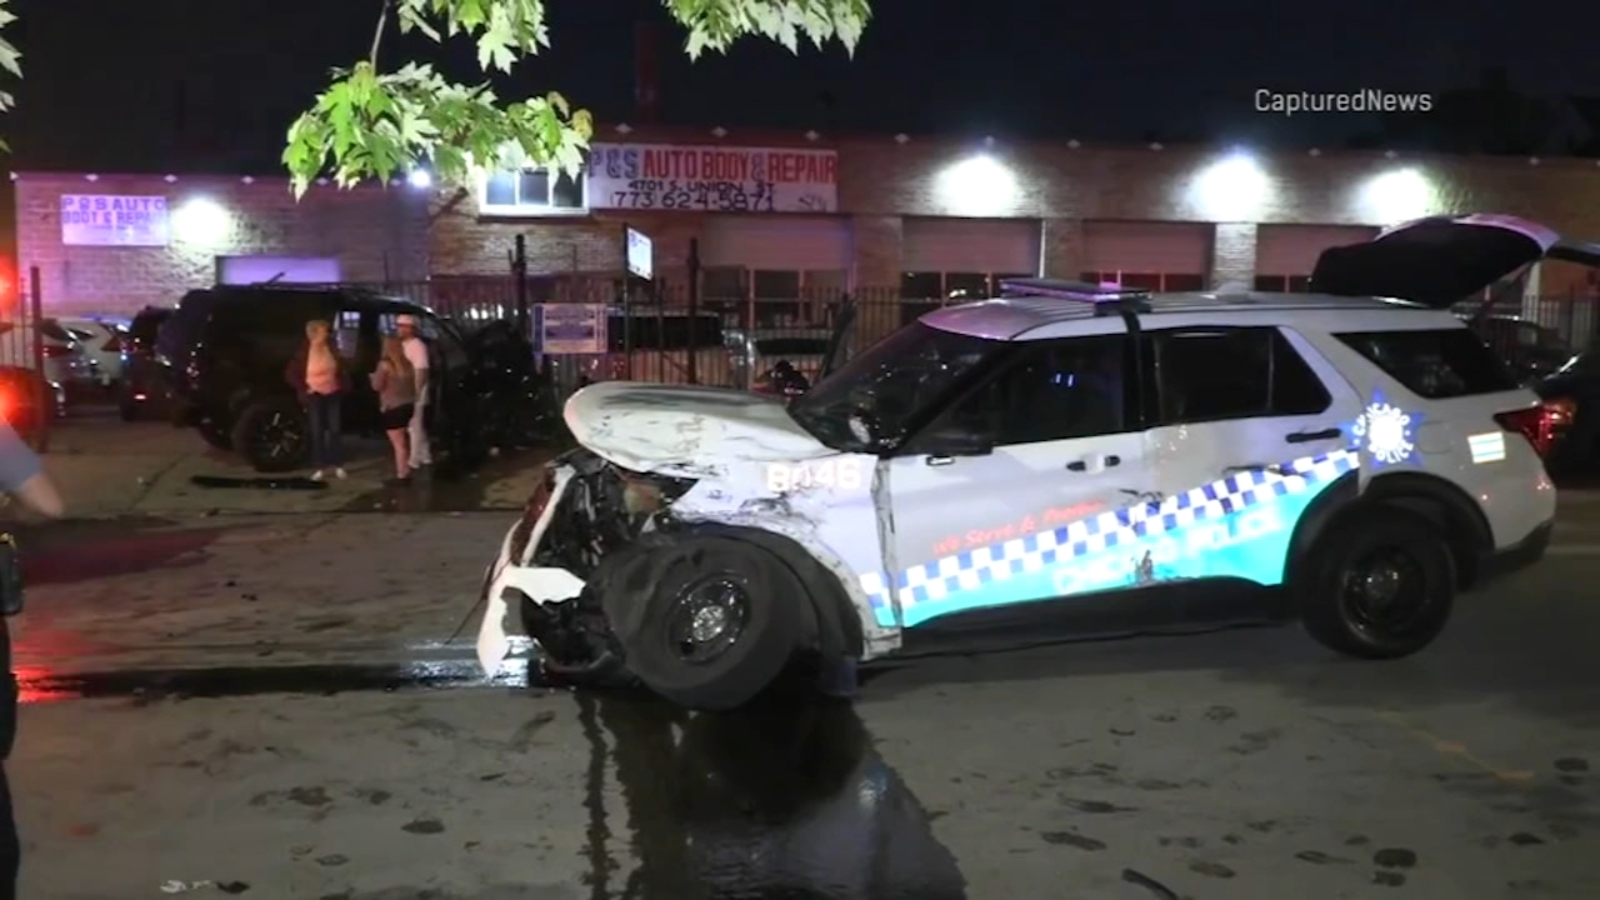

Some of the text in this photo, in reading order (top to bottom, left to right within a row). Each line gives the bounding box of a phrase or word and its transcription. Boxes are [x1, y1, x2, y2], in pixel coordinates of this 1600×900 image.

[642, 148, 699, 180] AUTO
[700, 150, 750, 181] BODY
[750, 152, 767, 182] &
[767, 152, 838, 184] REPAIR
[627, 179, 665, 192] 4701
[686, 181, 744, 194] UNION
[112, 198, 165, 211] AUTO
